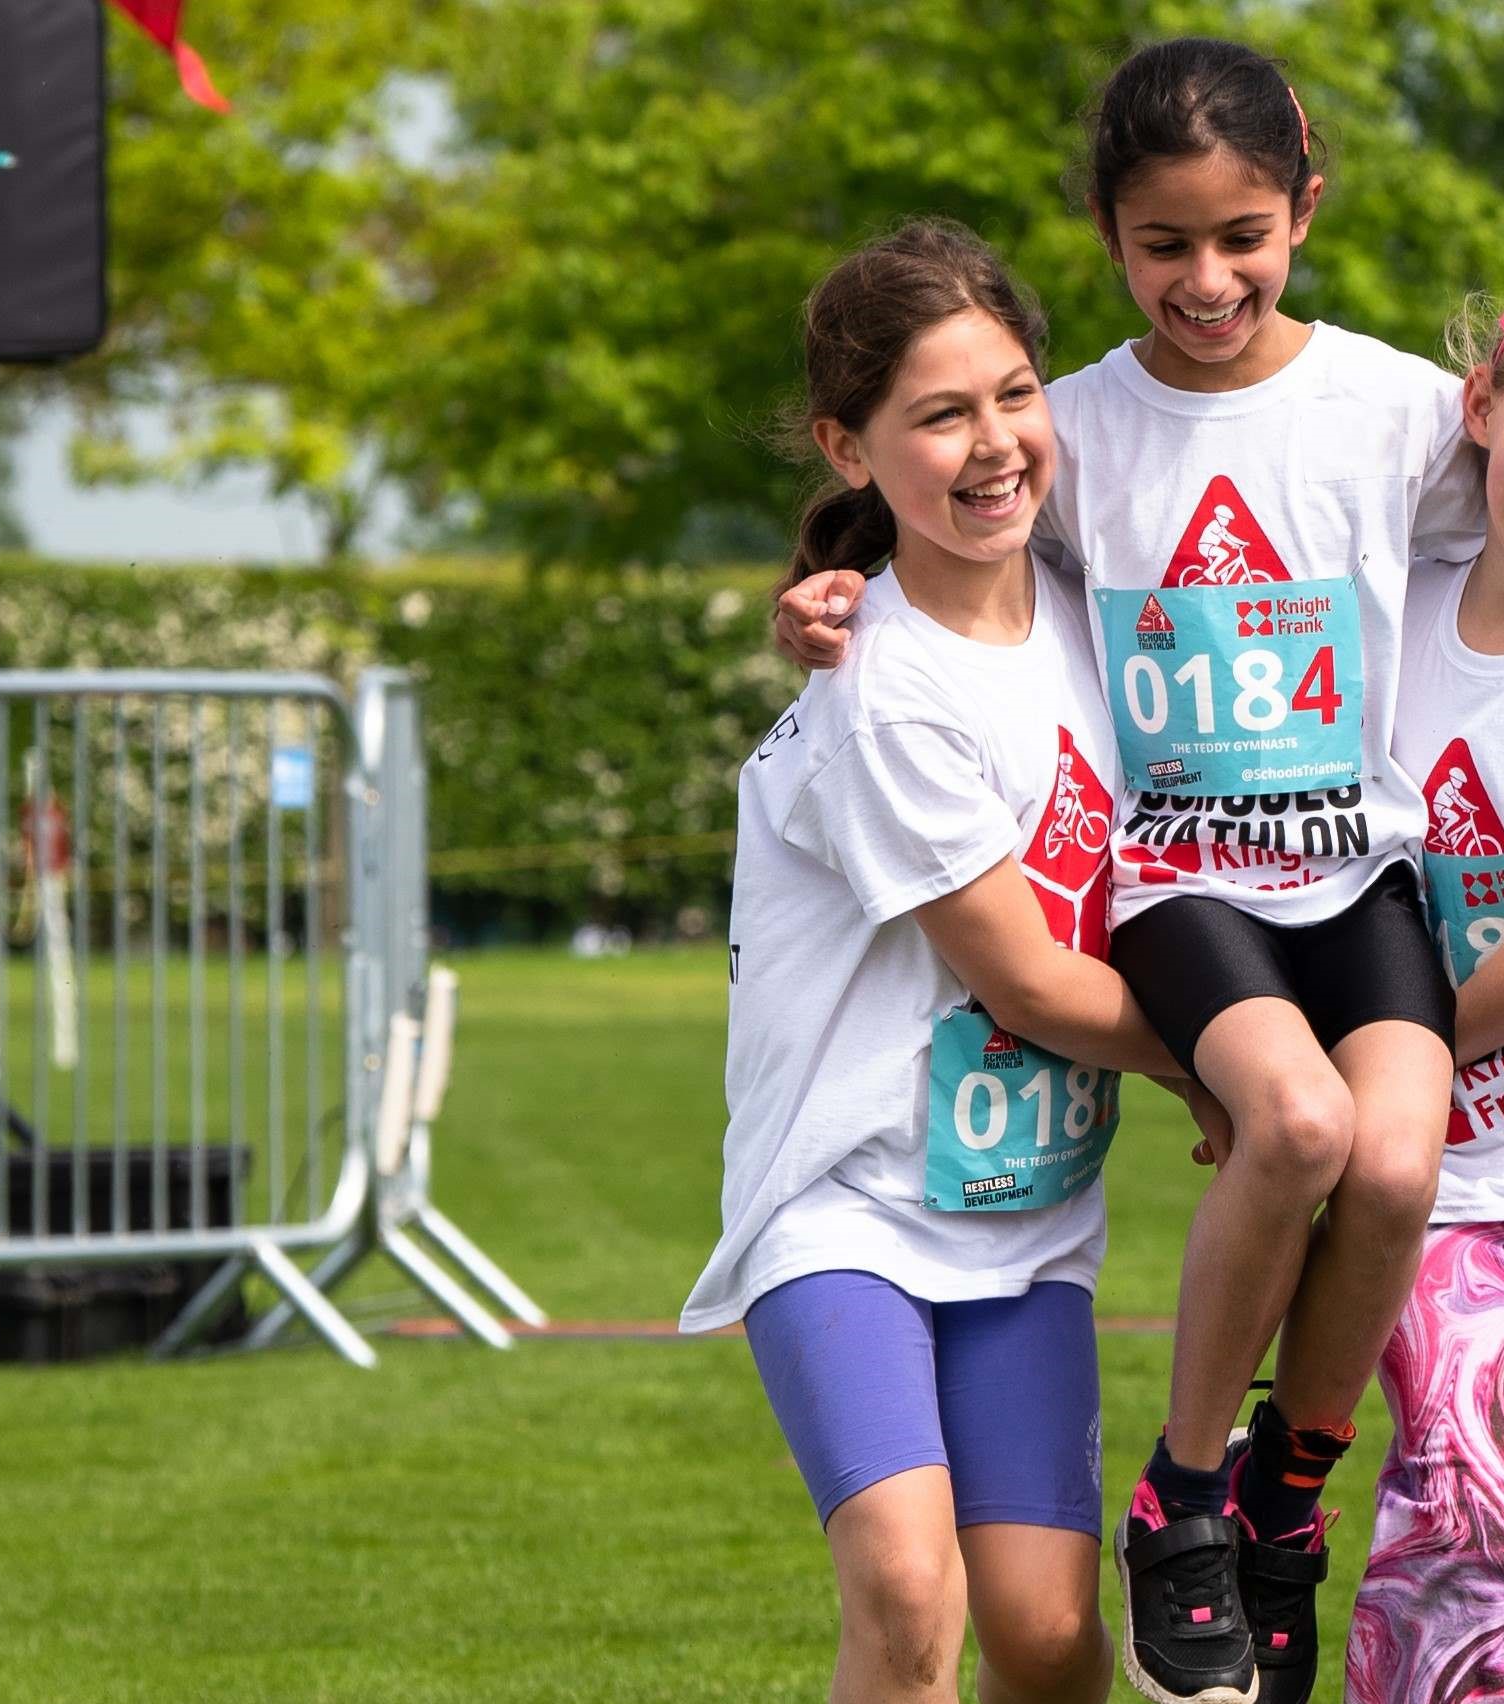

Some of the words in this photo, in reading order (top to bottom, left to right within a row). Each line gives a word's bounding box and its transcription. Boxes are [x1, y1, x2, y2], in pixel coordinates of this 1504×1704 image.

[1276, 596, 1332, 617] Knight
[1277, 615, 1324, 635] Frank
[1137, 631, 1175, 643] SCHOOLS
[1137, 641, 1176, 651] TRIATHLON
[1123, 645, 1343, 734] 0184
[1171, 742, 1192, 754] THE
[1193, 741, 1230, 754] TEDDY
[1233, 737, 1298, 751] GYMNASTS
[1148, 761, 1183, 775] RESTLESS
[1241, 761, 1354, 782] @SchoolsTriathlon
[1152, 771, 1202, 789] DEVELOPMENT
[983, 1051, 1024, 1064] SCHOOLS
[983, 1060, 1024, 1070] TRIATHLON
[953, 1060, 1114, 1150] 018
[1004, 1157, 1027, 1169] THE
[1030, 1152, 1058, 1167] TEDDY
[964, 1176, 1015, 1194] RESTLESS
[964, 1184, 1034, 1208] DEVELOPMENT
